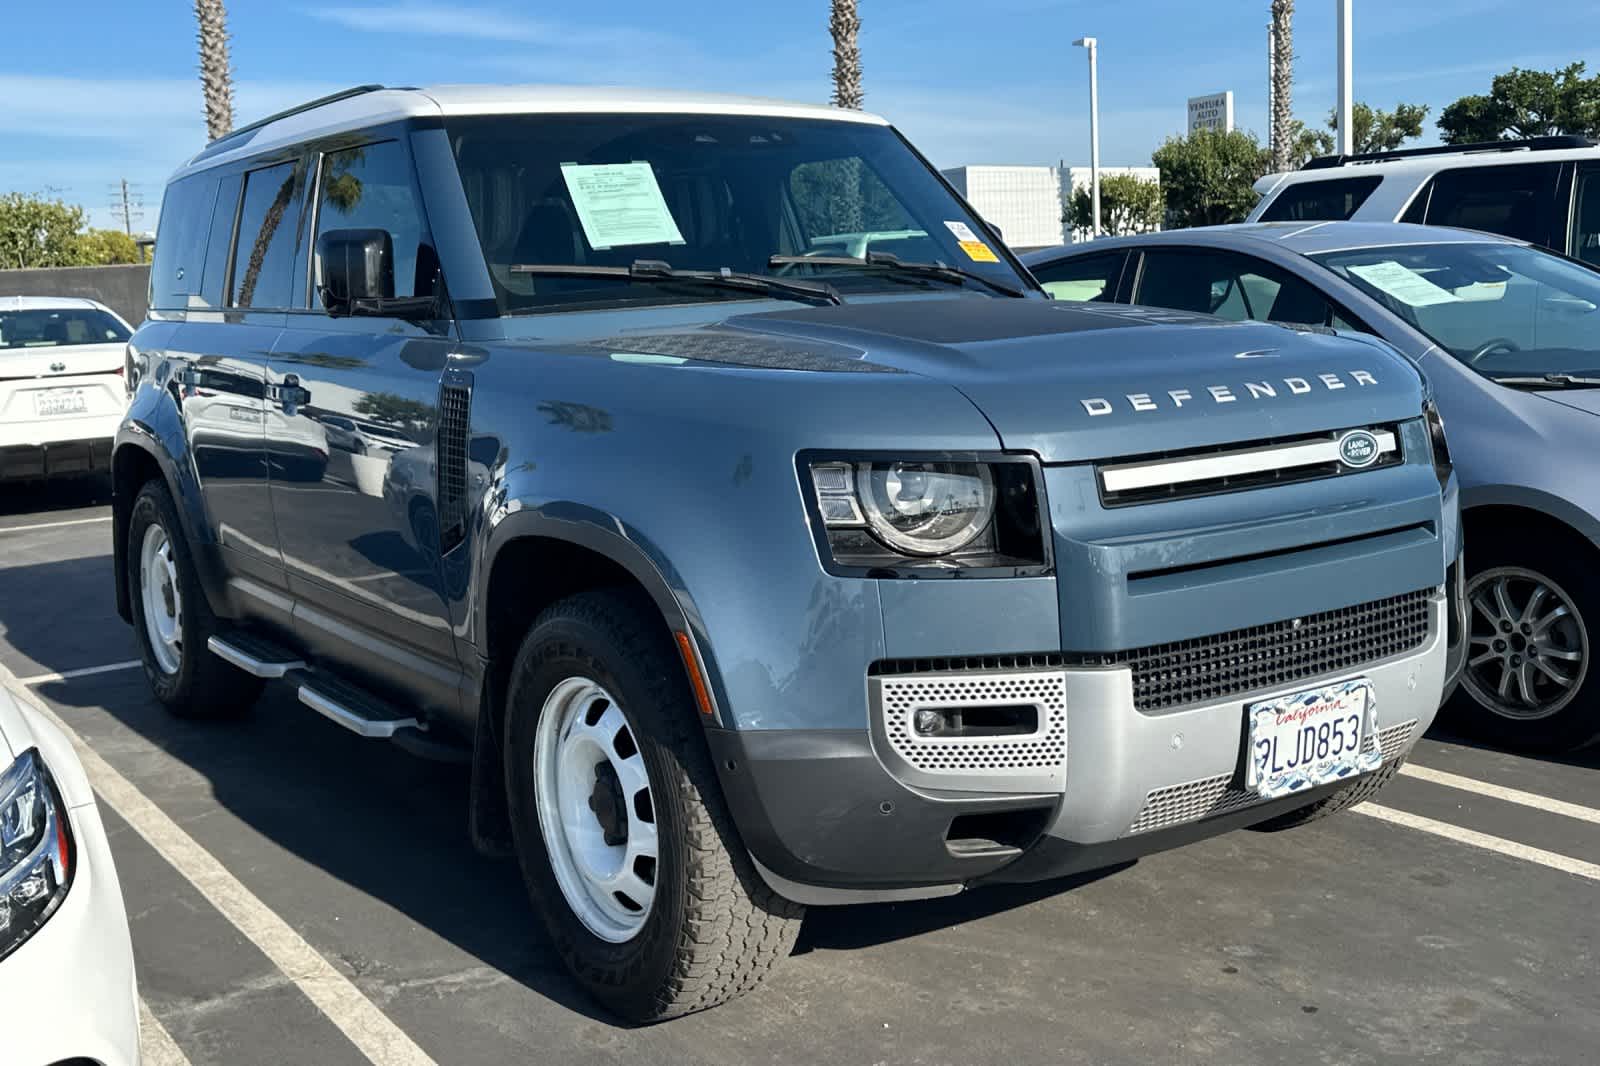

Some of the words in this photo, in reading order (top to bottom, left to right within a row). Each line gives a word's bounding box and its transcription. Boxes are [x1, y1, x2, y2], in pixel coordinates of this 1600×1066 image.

[1189, 99, 1224, 112] VENTURA
[1197, 109, 1218, 120] AUTO
[1192, 119, 1223, 129] CETE
[1080, 370, 1378, 416] DEFENDER
[1348, 440, 1365, 450] LAND
[1351, 447, 1370, 457] ROVER
[1275, 699, 1347, 726] California
[1256, 714, 1360, 773] 9LJD853
